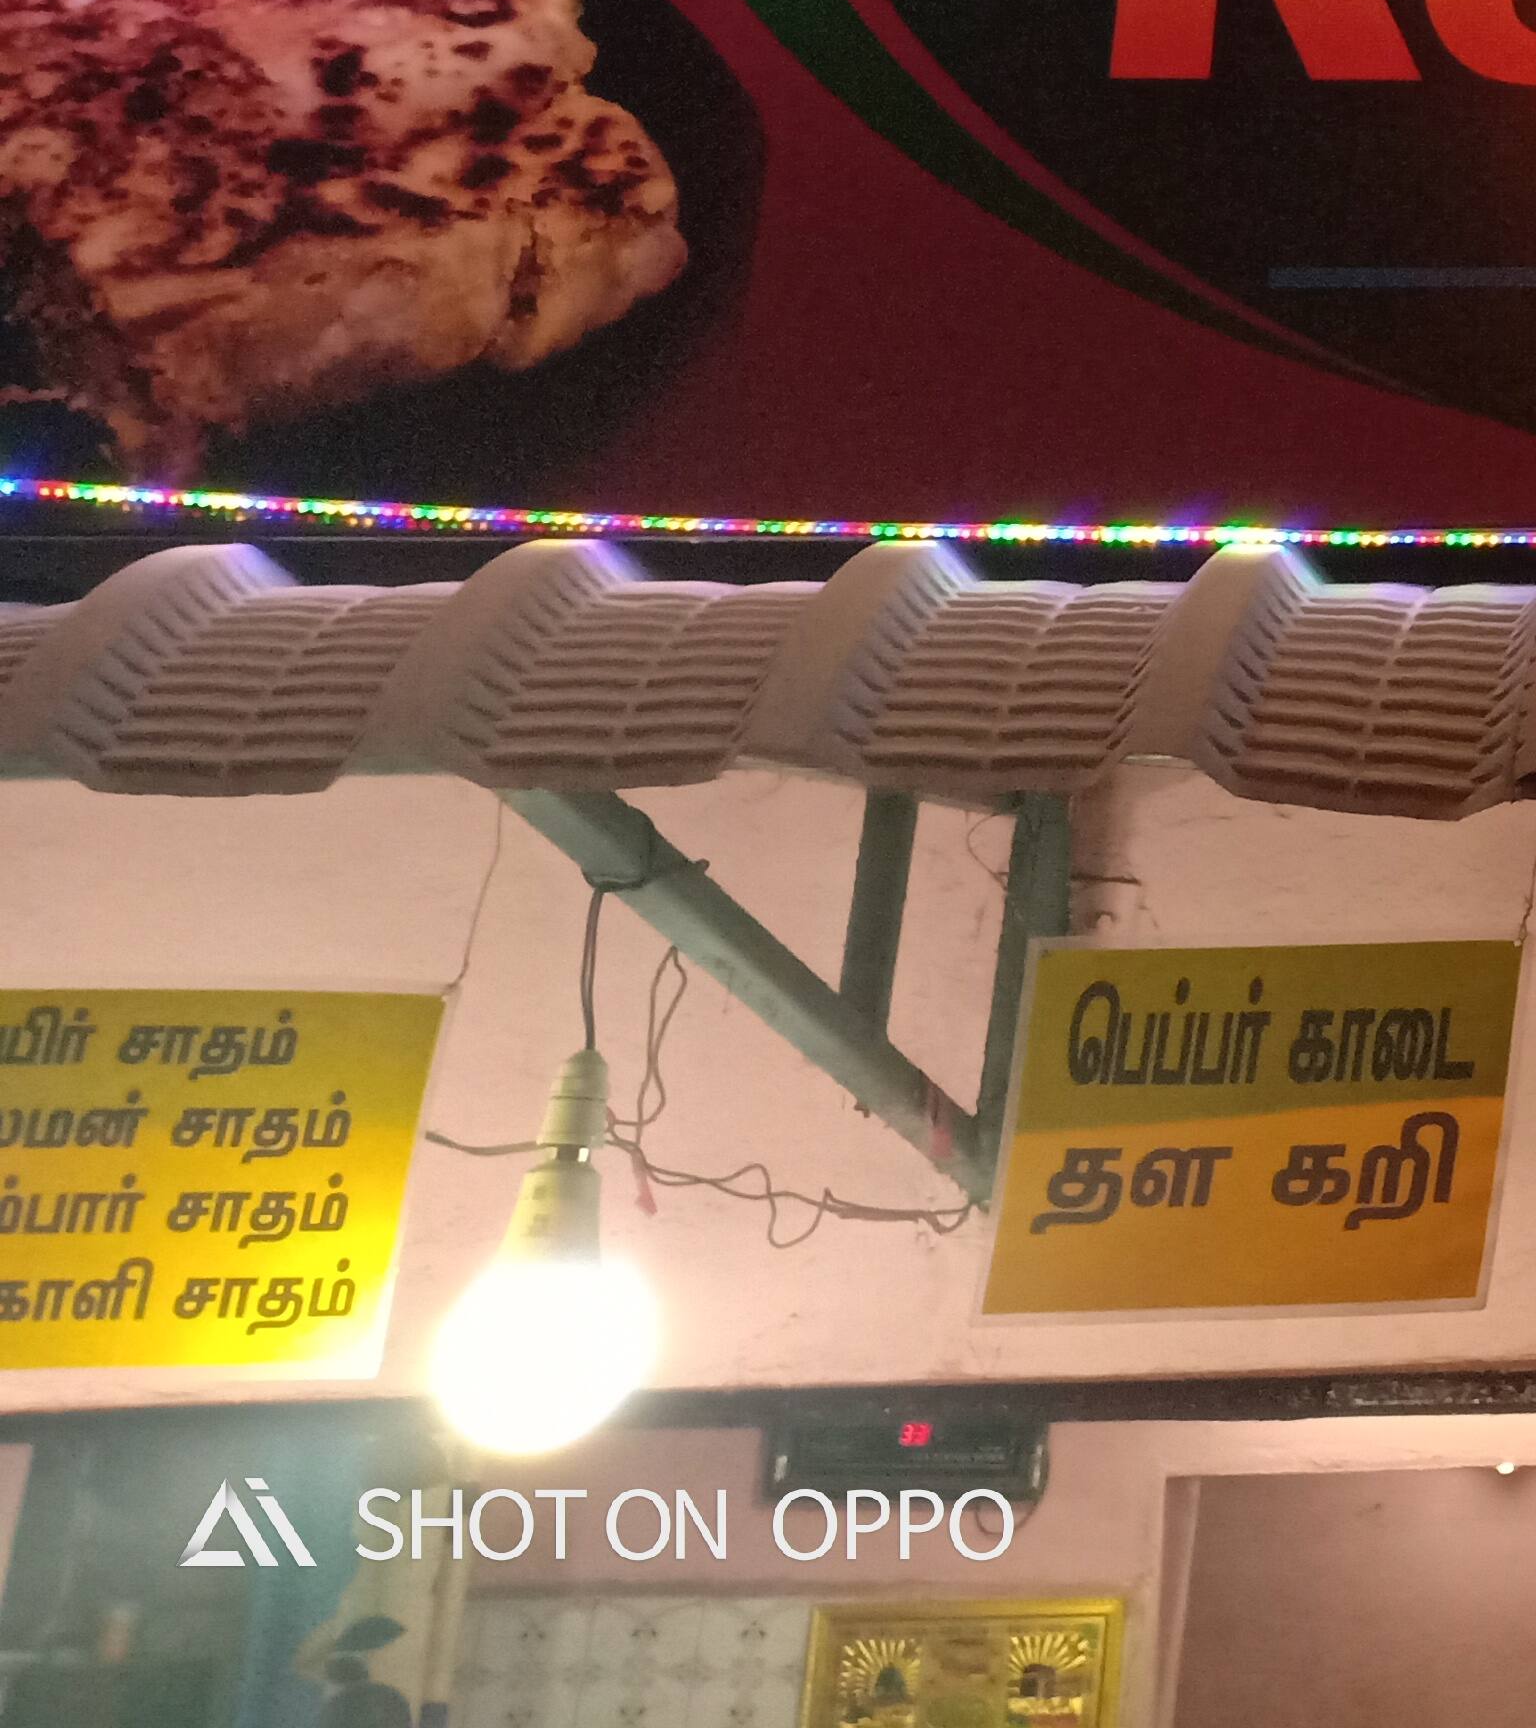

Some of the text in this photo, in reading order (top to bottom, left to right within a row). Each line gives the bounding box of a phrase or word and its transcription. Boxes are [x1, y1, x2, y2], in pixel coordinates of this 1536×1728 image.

[117, 1009, 299, 1080] சாதம்
[1068, 976, 1475, 1085] பெப்பர் காடை
[170, 1090, 351, 1164] சாதம்
[1272, 1111, 1459, 1231] கறி
[166, 1173, 349, 1249] சாதம்
[173, 1258, 356, 1336] சாதம்
